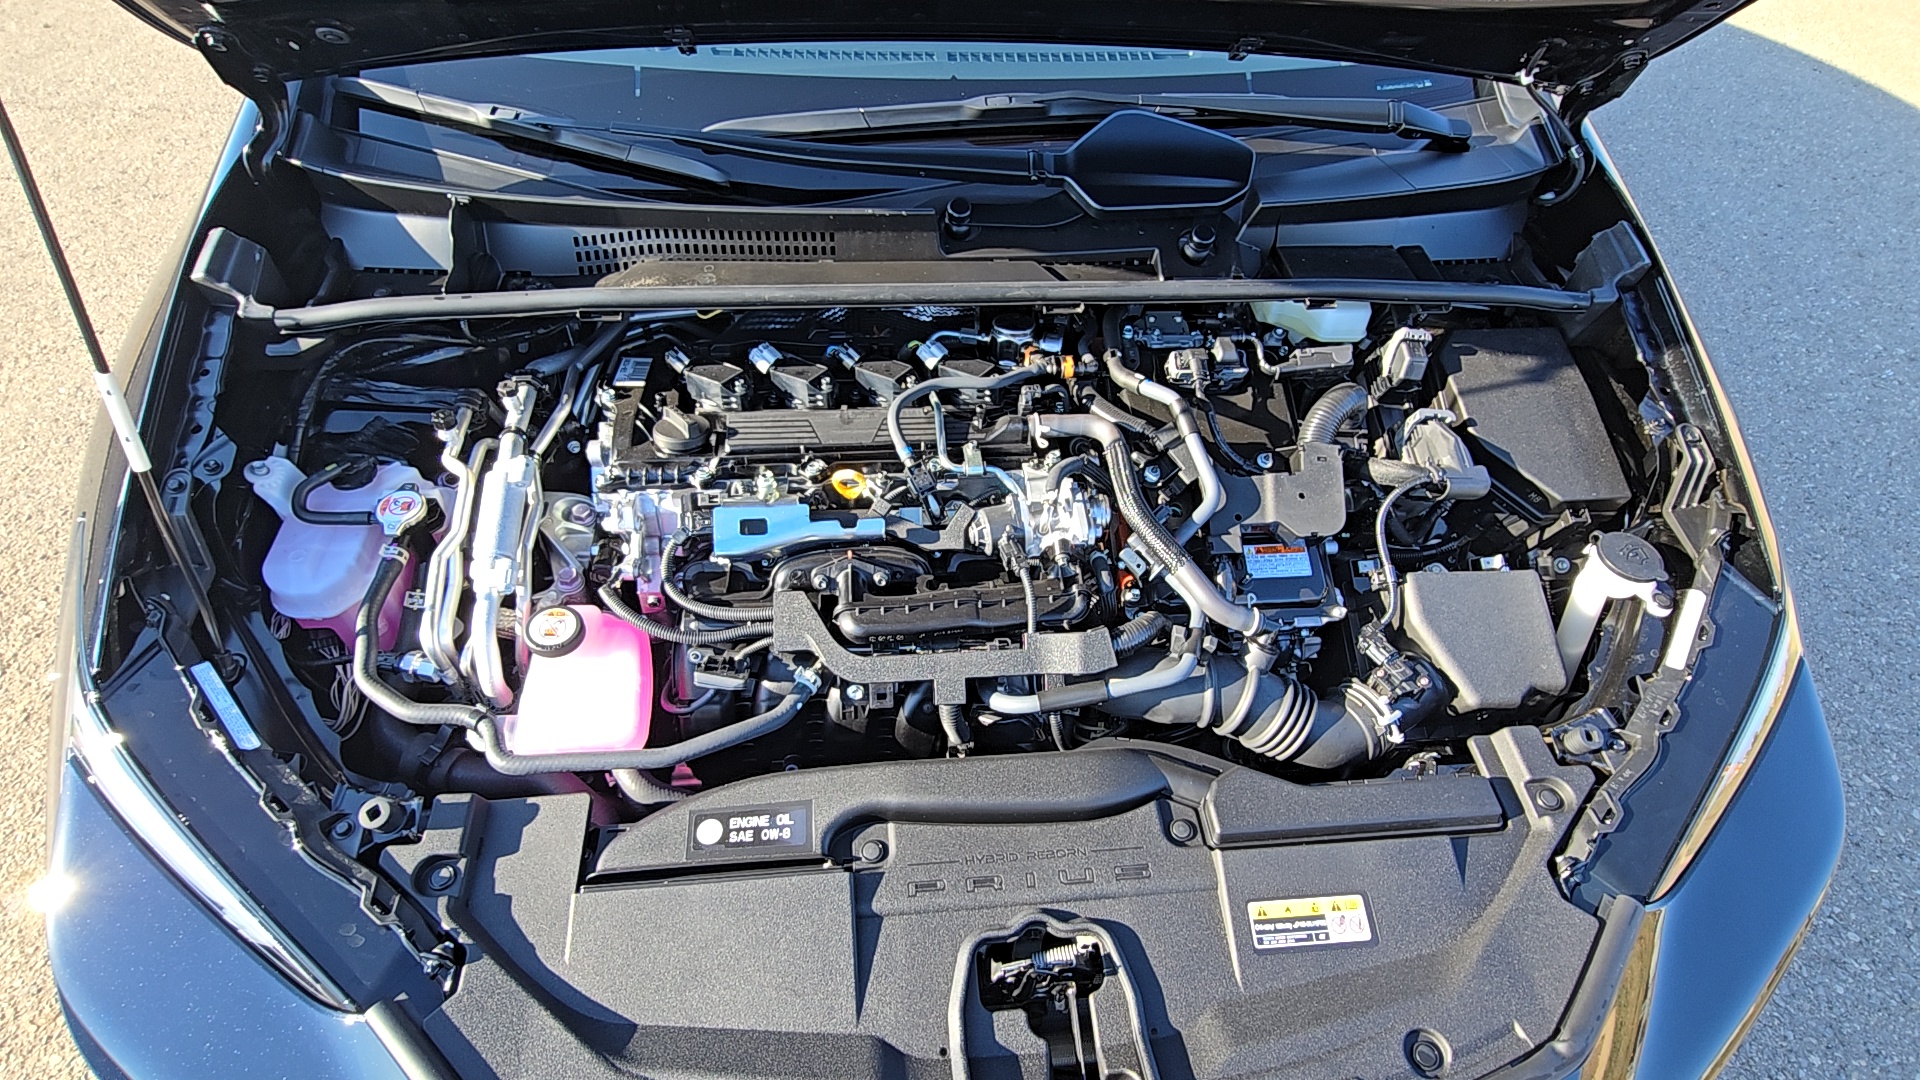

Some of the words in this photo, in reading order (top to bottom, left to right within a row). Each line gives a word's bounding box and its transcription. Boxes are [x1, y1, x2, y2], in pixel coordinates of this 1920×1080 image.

[729, 814, 770, 829] ENGINE
[776, 813, 795, 826] OIL
[728, 830, 754, 843] SAE
[964, 852, 1020, 865] HYBRID
[1026, 848, 1089, 862] REBORN
[907, 863, 1152, 898] PRIUS
